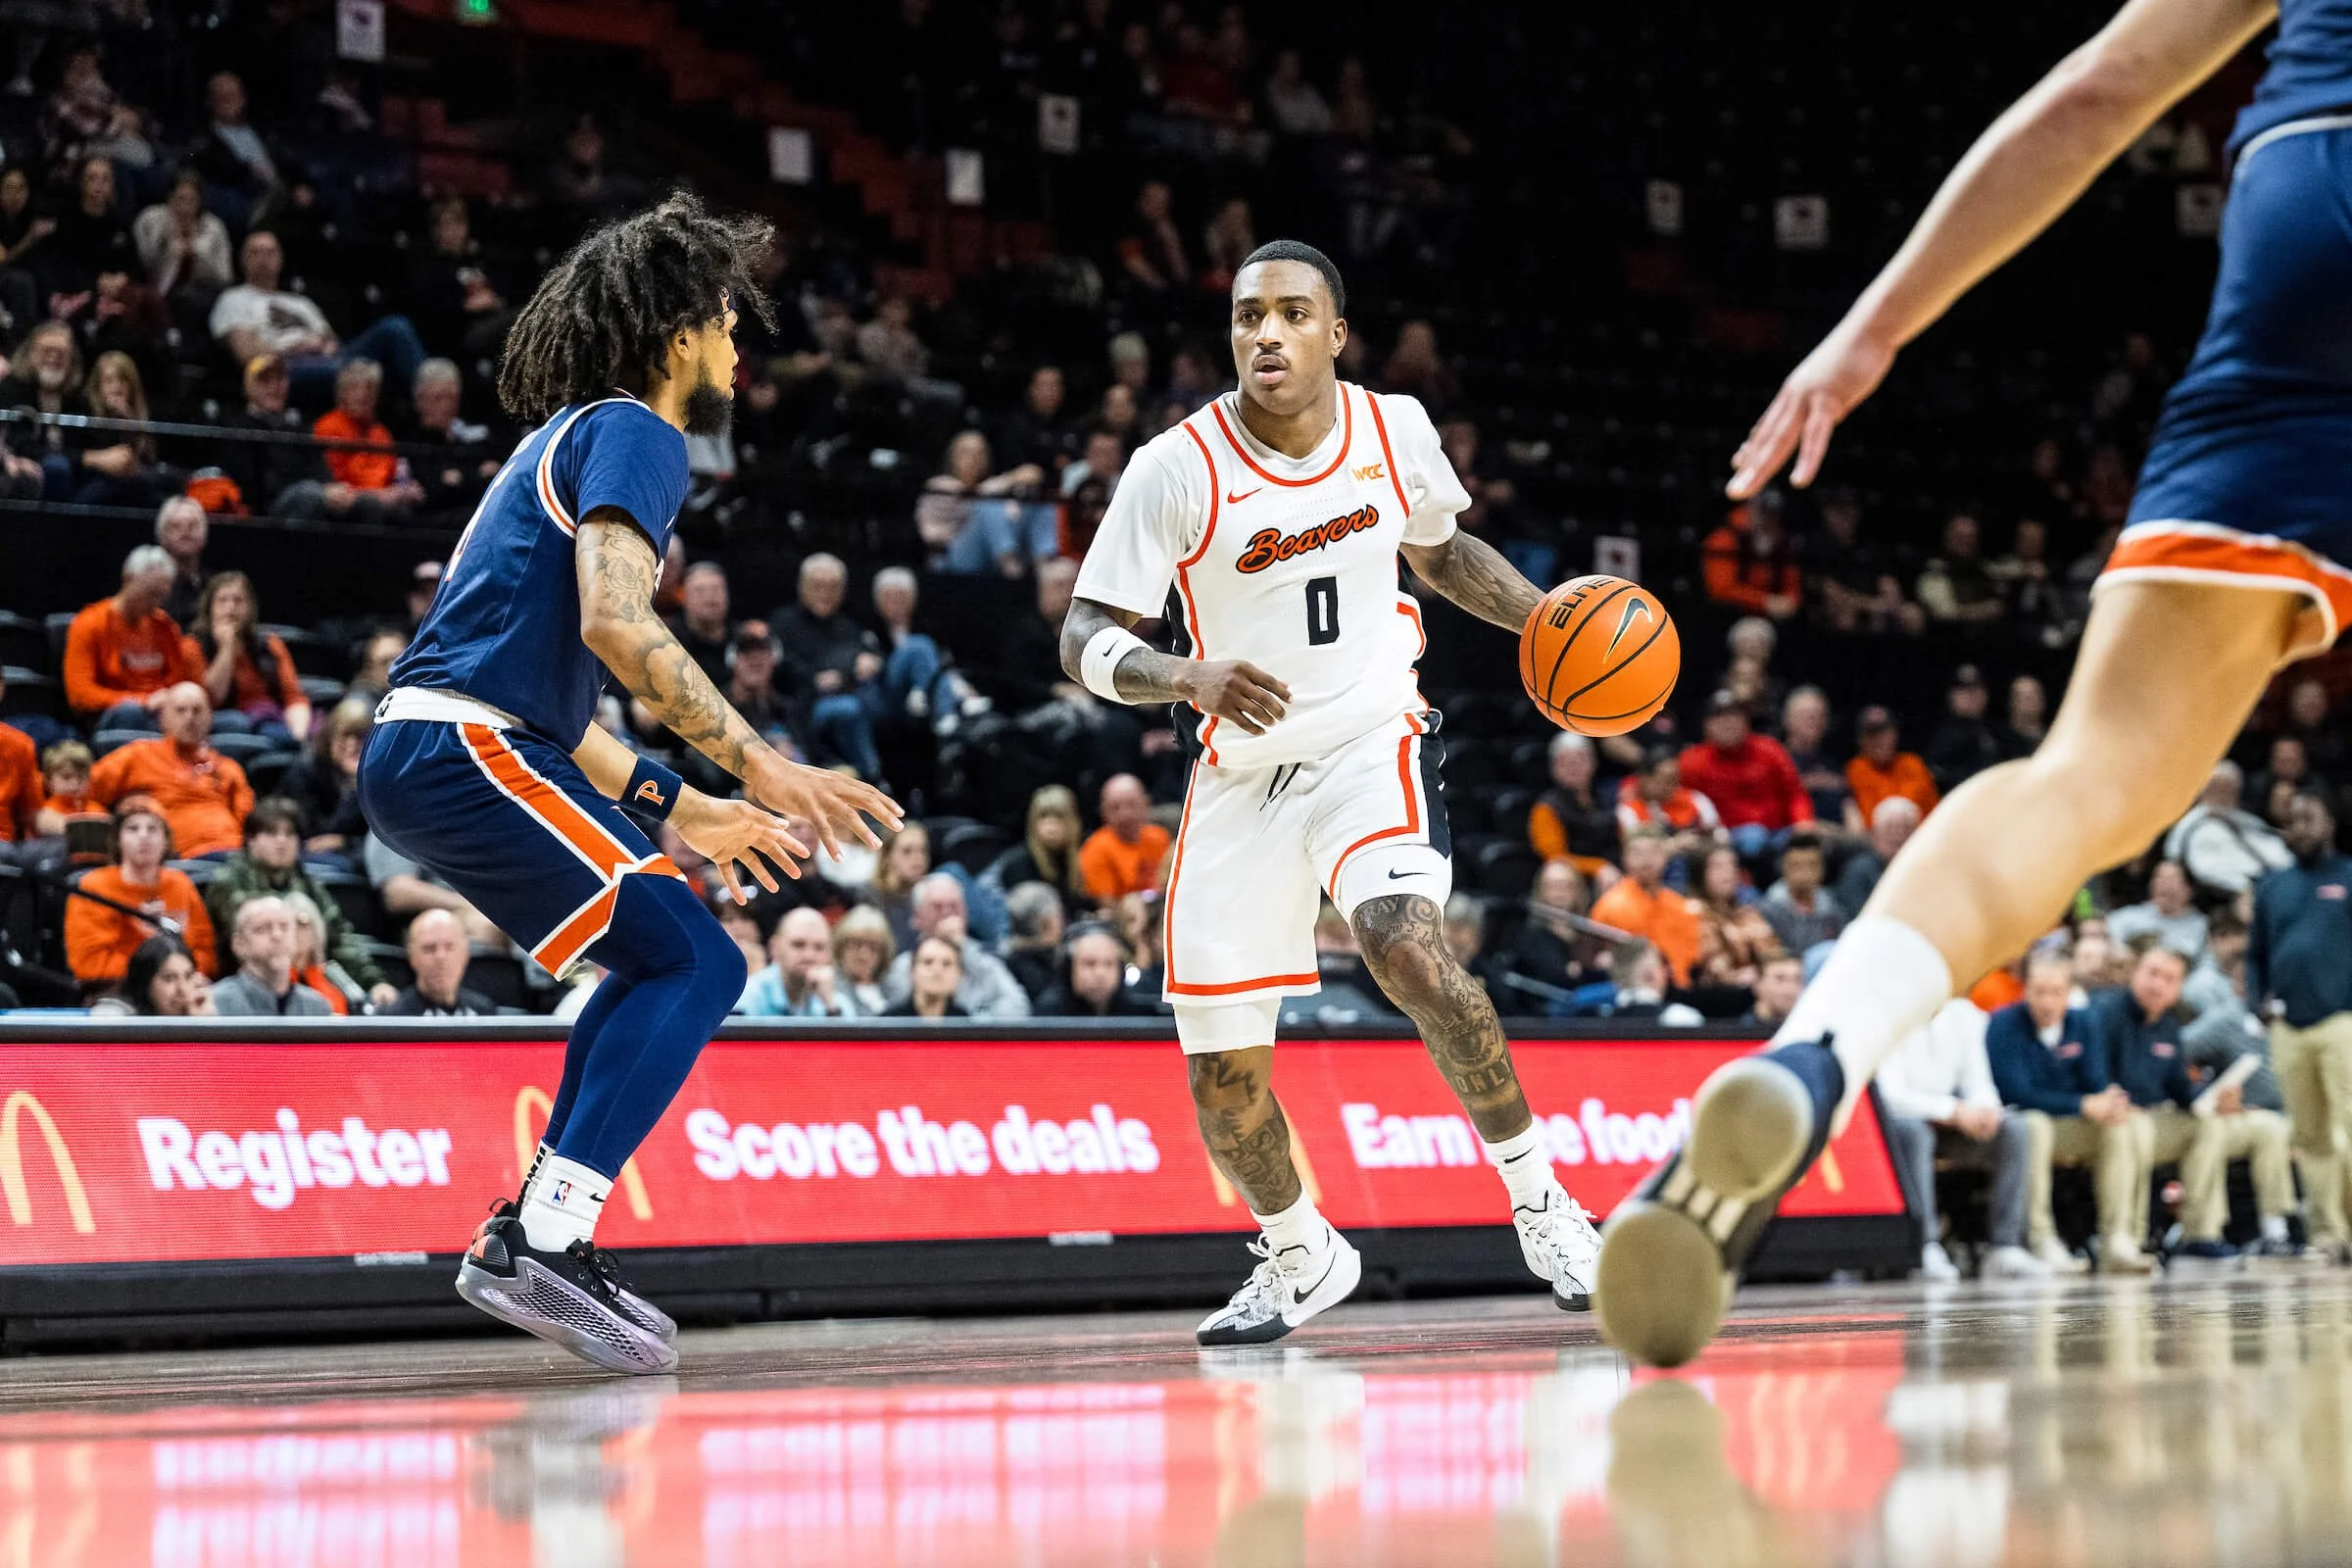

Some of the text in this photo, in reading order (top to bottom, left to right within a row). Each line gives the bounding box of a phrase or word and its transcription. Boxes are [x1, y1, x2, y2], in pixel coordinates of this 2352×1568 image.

[1236, 504, 1379, 574] Beavers
[1305, 576, 1340, 646] 0
[634, 780, 665, 807] P
[136, 1106, 453, 1210] Register
[685, 1107, 879, 1181] Score
[876, 1105, 991, 1177] the
[991, 1103, 1161, 1175] deals
[1341, 1102, 1479, 1168] Earn
